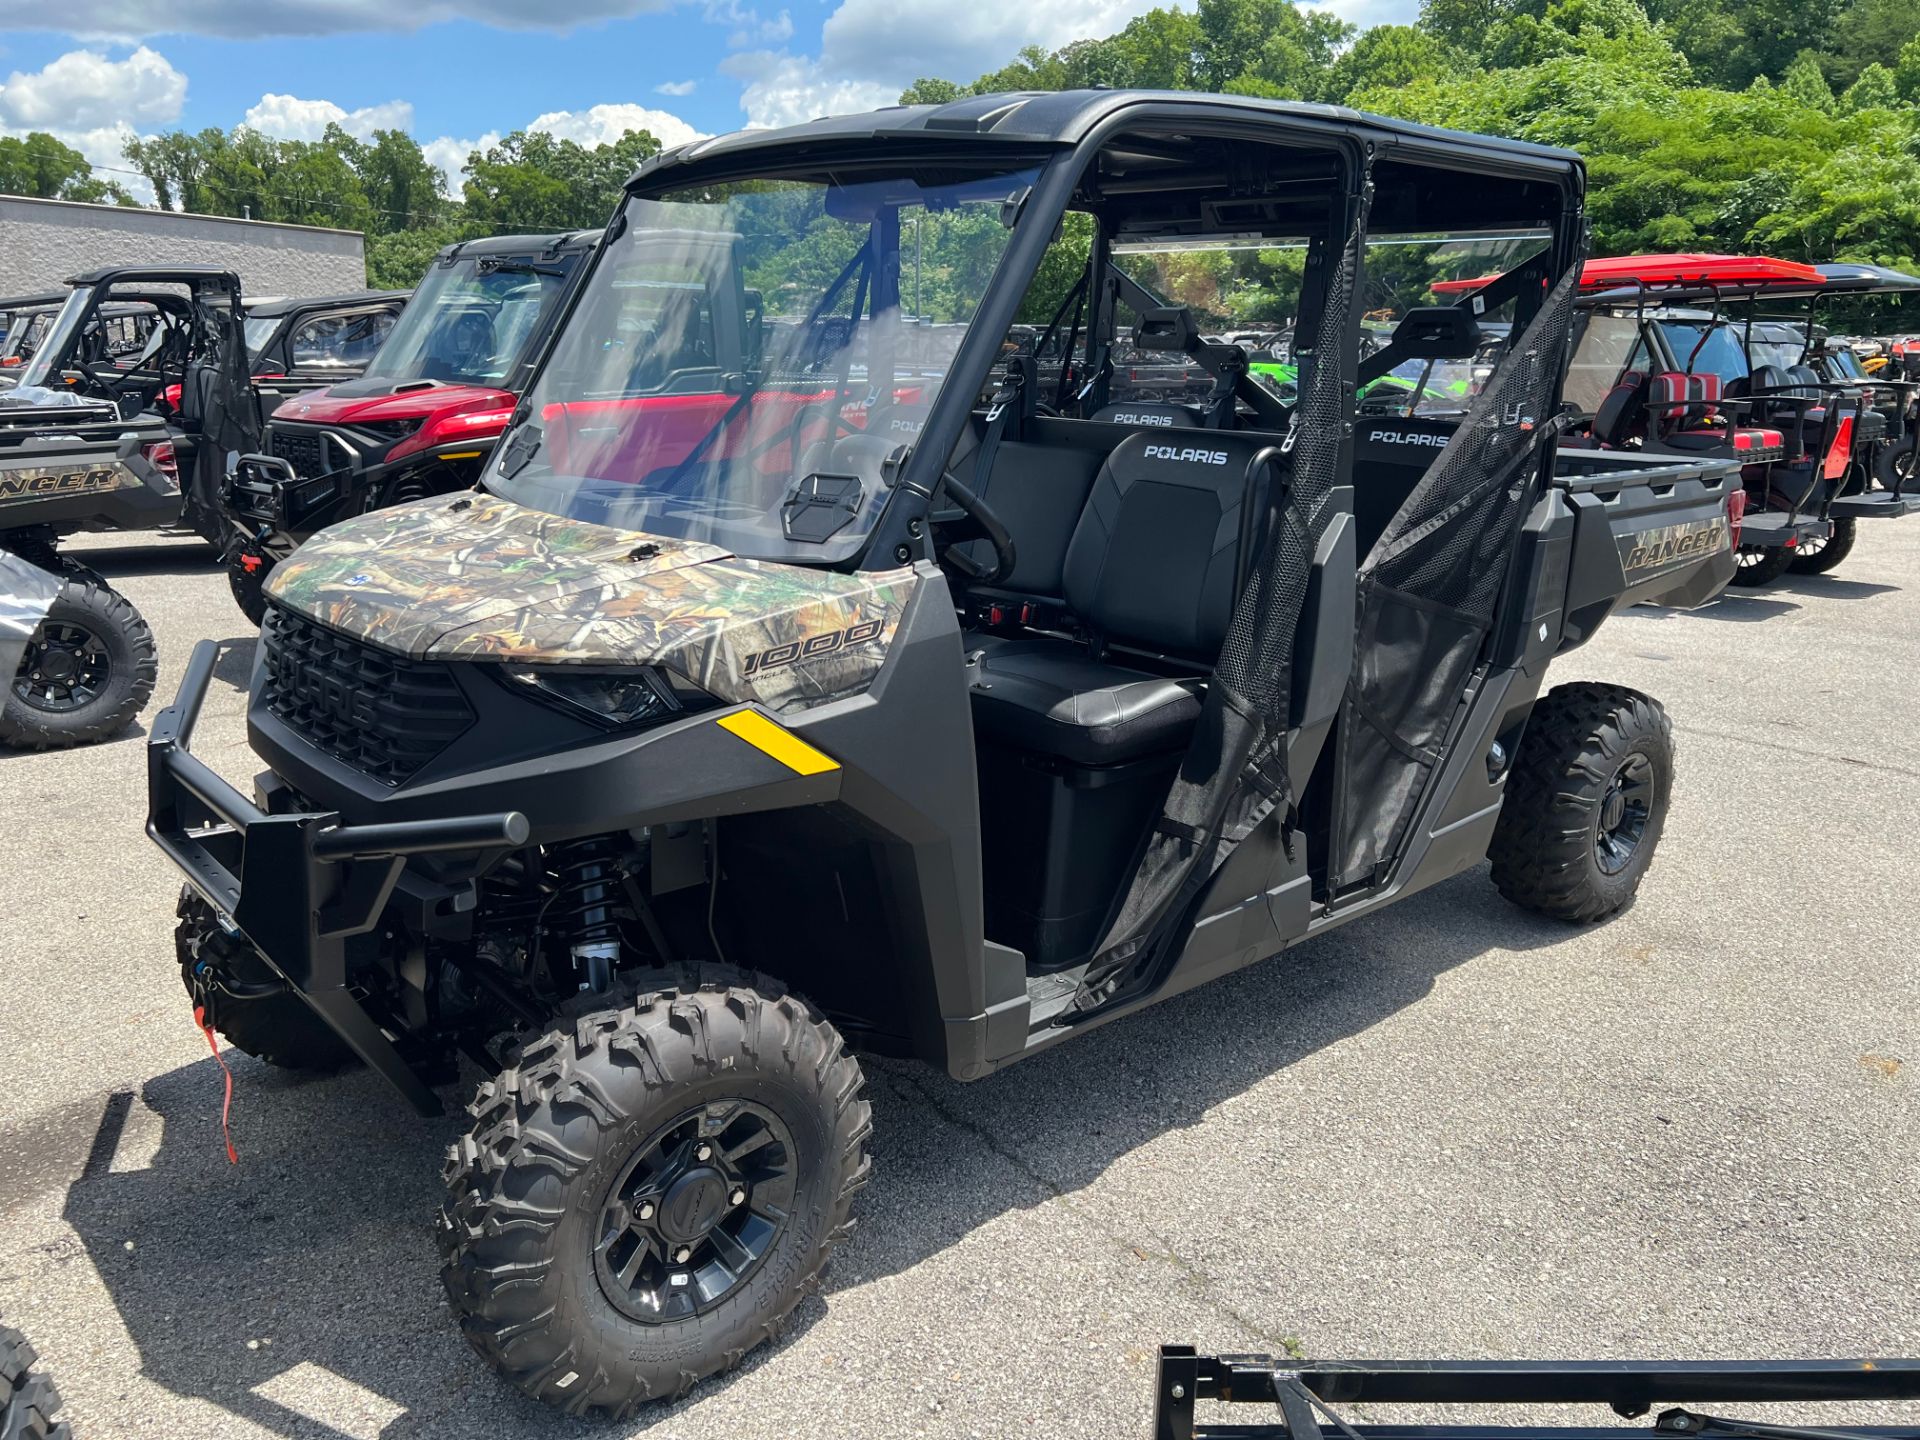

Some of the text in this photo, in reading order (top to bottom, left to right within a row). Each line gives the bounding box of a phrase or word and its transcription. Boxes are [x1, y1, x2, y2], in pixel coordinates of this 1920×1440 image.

[1114, 413, 1173, 426] POLARIS
[1144, 445, 1228, 466] POLARIS
[1370, 430, 1450, 448] POLARIS
[1624, 526, 1722, 571] RANGER
[744, 619, 884, 675] 1000
[264, 637, 378, 730] POLARIS
